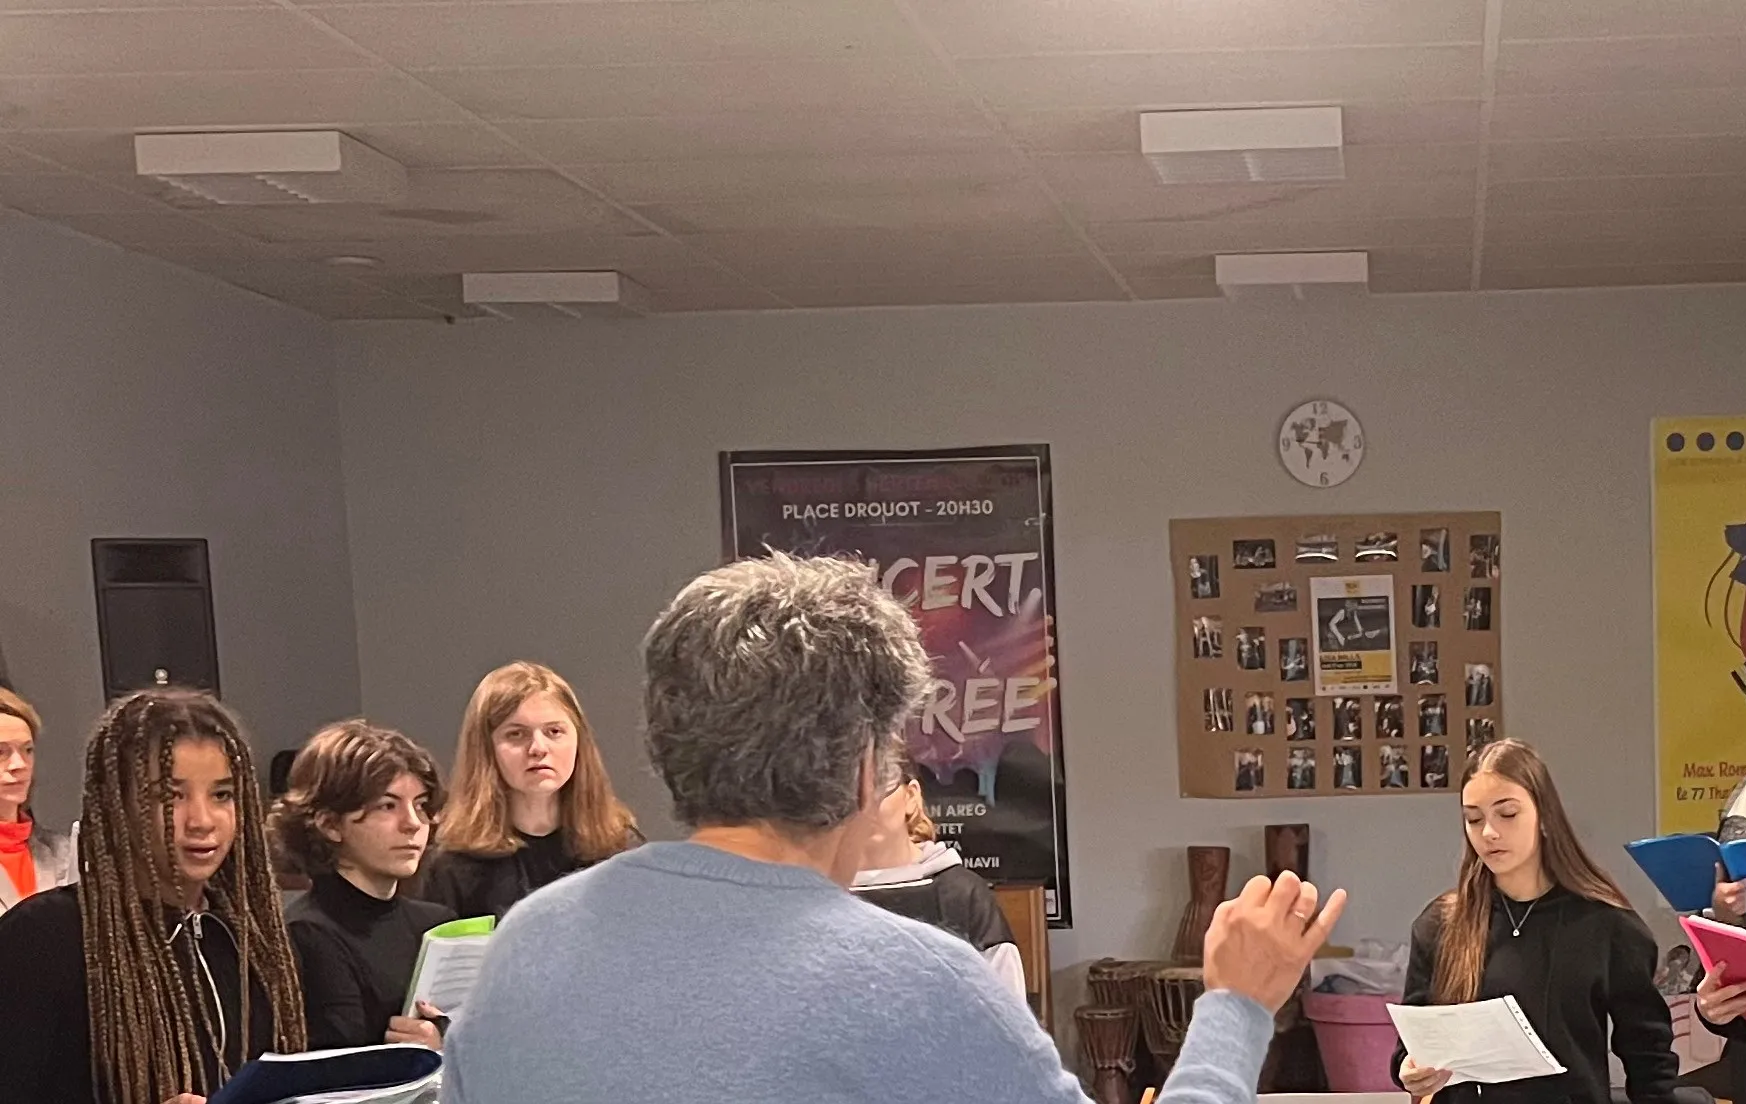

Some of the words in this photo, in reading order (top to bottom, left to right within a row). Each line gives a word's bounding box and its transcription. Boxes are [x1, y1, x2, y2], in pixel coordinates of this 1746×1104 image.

[1320, 472, 1329, 486] 6
[782, 503, 839, 519] PLACE
[844, 502, 921, 517] DROUOT
[936, 500, 994, 516] 20H30
[869, 552, 1039, 618] CERT
[1683, 763, 1715, 778] Max
